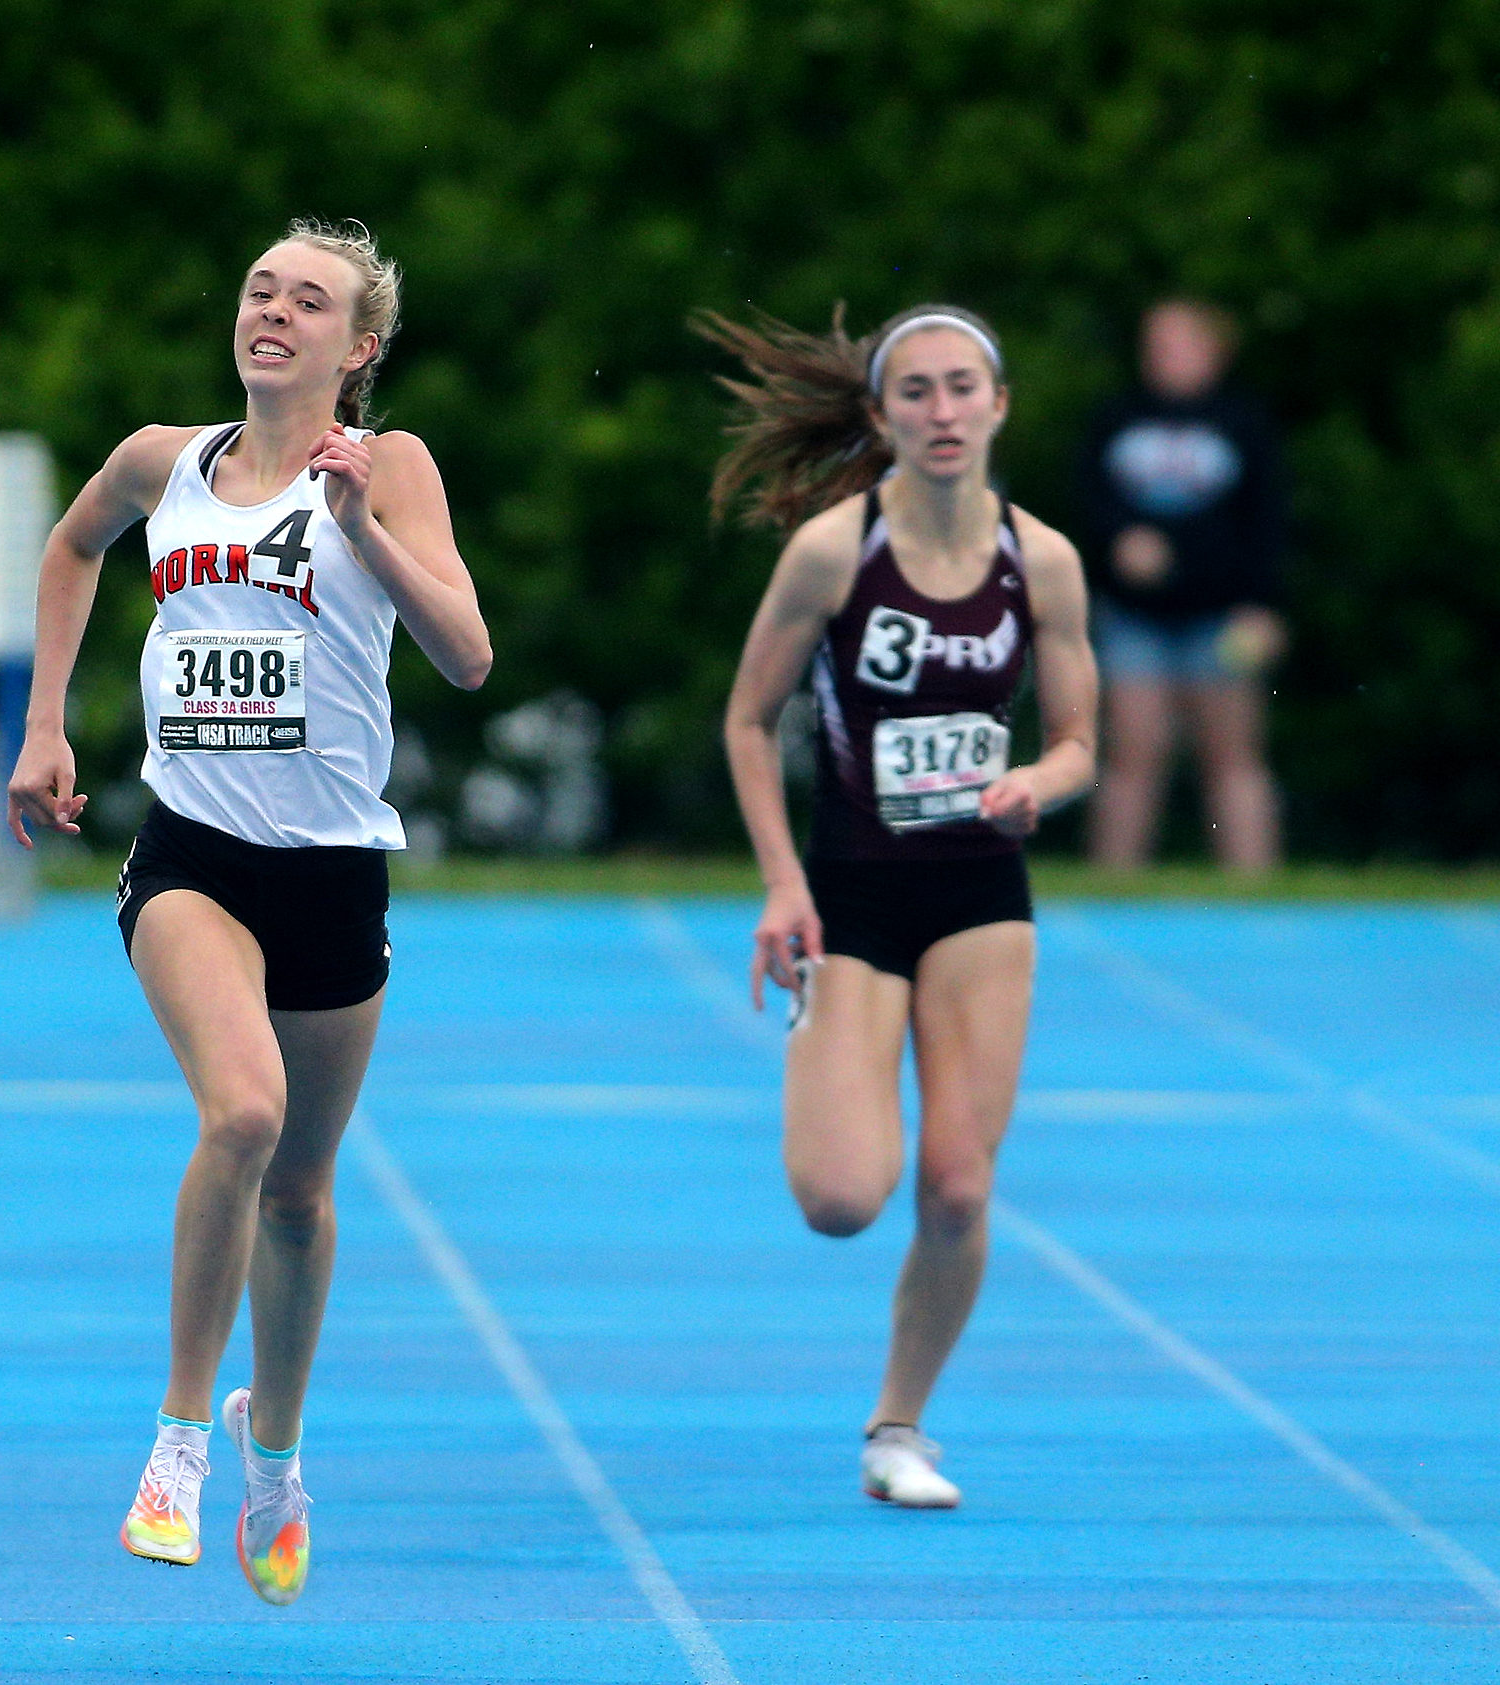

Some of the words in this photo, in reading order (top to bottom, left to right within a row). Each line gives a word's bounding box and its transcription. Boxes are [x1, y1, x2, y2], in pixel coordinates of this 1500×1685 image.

[253, 509, 313, 577] 4
[202, 637, 218, 645] STATE
[219, 637, 238, 645] TRACK
[240, 637, 245, 645] &
[246, 637, 264, 645] FIELD
[265, 637, 283, 645] MEET
[867, 614, 915, 681] 3
[176, 649, 285, 697] 3498
[184, 701, 217, 713] CLASS
[221, 701, 236, 713] 3A
[240, 701, 276, 714] GIRLS
[197, 724, 226, 745] IHSA
[227, 725, 270, 745] TRACK
[893, 727, 991, 774] 3178
